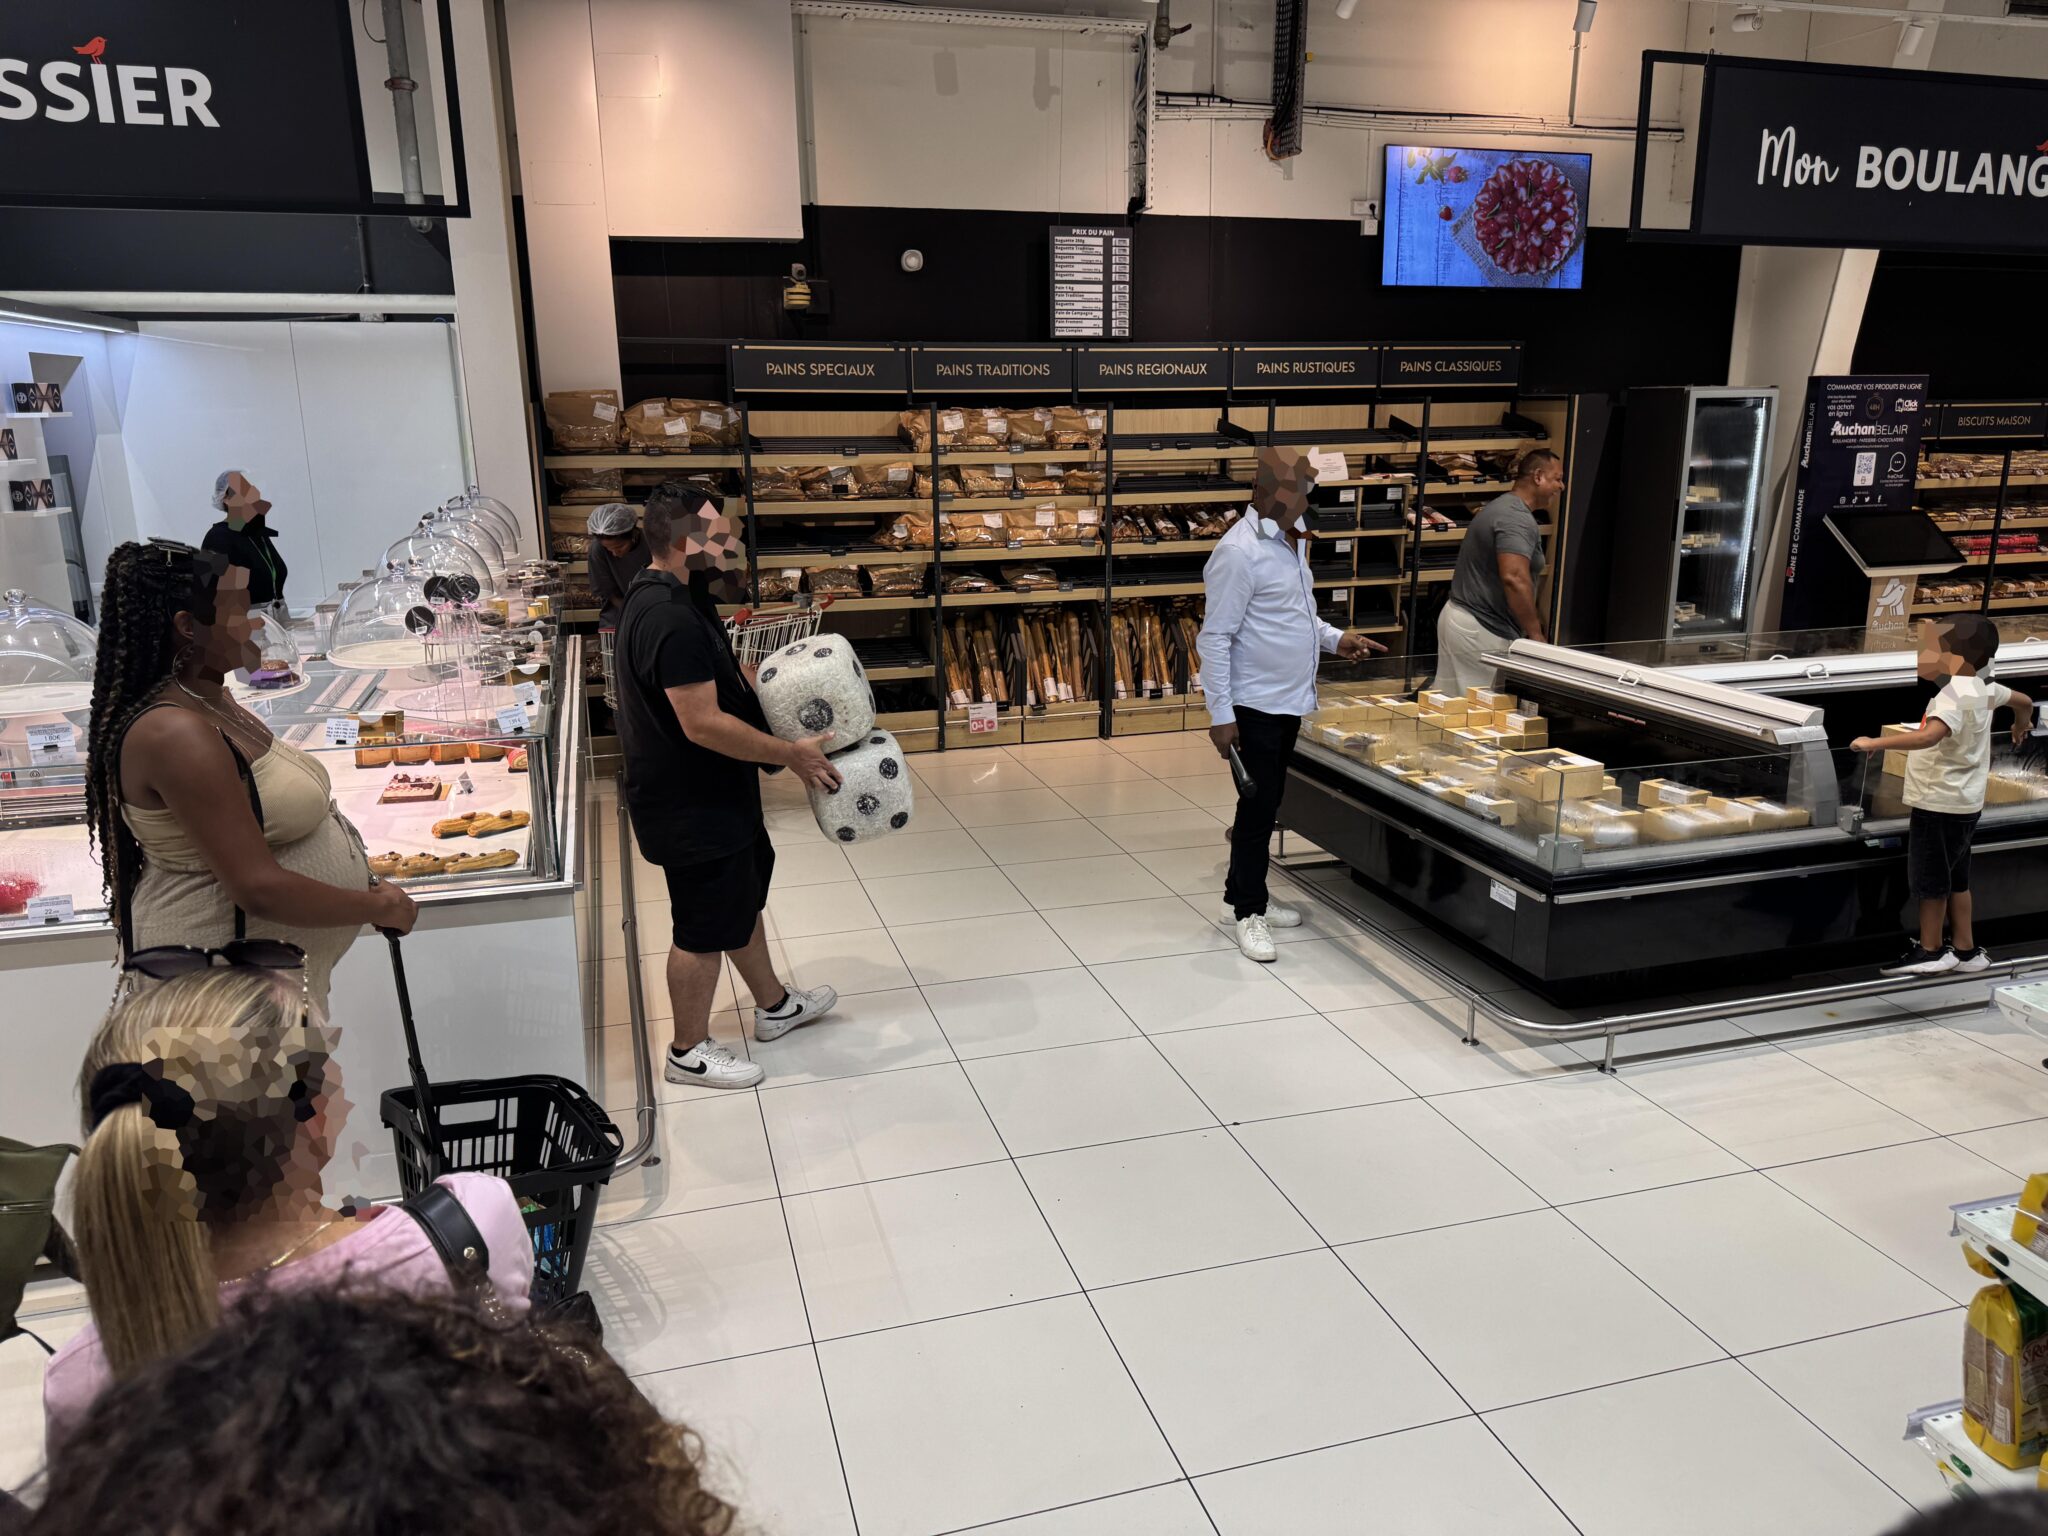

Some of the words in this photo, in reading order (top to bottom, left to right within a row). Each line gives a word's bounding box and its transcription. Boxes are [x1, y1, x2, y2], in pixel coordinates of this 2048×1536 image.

[0, 58, 221, 128] SSIER
[1757, 125, 1840, 188] Mon
[1855, 145, 2048, 198] BOULANG
[1072, 228, 1087, 236] PRIX
[1088, 228, 1098, 236] DU
[1099, 229, 1115, 237] PAIN
[766, 362, 806, 376] PAINS
[809, 363, 876, 377] SPECIAUX
[936, 363, 974, 376] PAINS
[976, 363, 1051, 377] TRADITIONS
[1099, 363, 1134, 376] PAINS
[1136, 362, 1208, 376] REGIONAUX
[1256, 362, 1290, 374] PAINS
[1292, 361, 1356, 374] RUSTIQUES
[1400, 361, 1432, 373] PAINS
[1434, 360, 1502, 373] CLASSIQUES
[1836, 410, 1849, 418] ligne
[1957, 416, 1995, 427] BISCUITS
[1996, 415, 2031, 426] MAISON
[1830, 420, 1875, 436] Auchan
[1801, 431, 1813, 469] Auchan
[1793, 488, 1805, 541] COMMANDE
[1791, 543, 1799, 554] DE
[1870, 620, 1905, 631] Auchan
